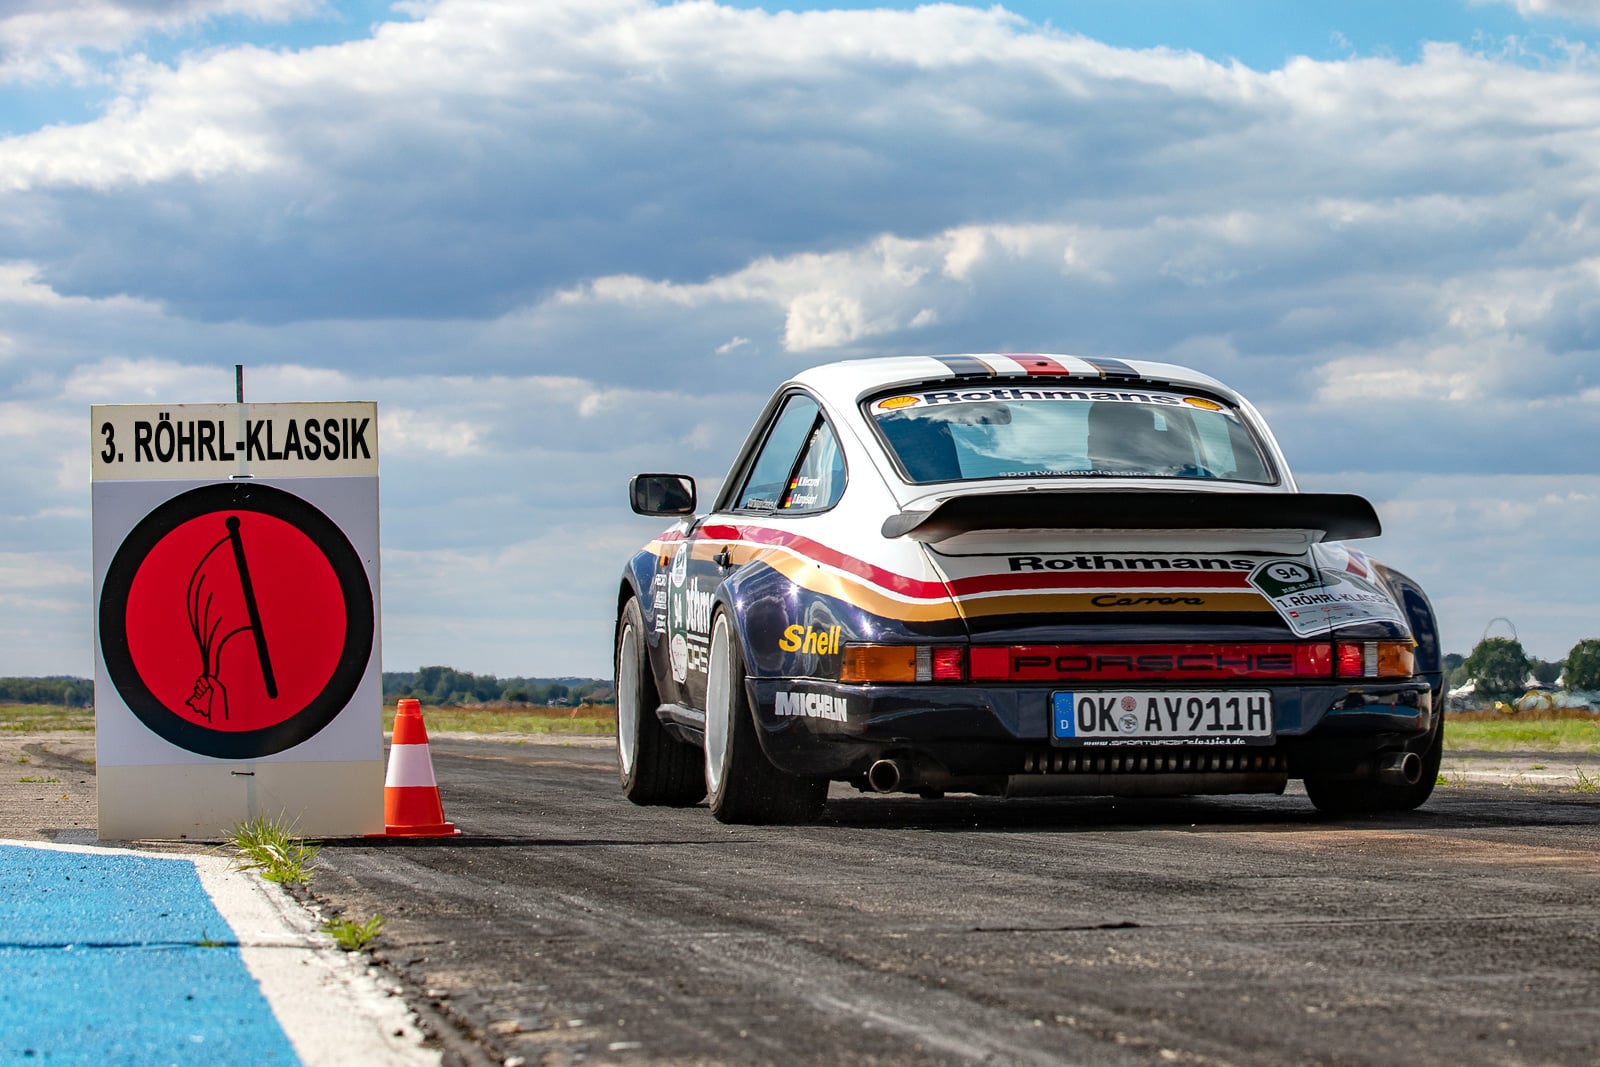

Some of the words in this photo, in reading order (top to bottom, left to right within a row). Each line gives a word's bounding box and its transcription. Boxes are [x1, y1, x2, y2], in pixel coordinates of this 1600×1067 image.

[923, 389, 1180, 405] Rothmans
[100, 422, 124, 464] 3.
[134, 412, 371, 463] RÖHRL-KLASSIK
[1008, 555, 1255, 572] Rothmans
[1275, 567, 1302, 580] 94
[1091, 594, 1206, 608] Carrera
[778, 624, 842, 656] Shell
[1014, 653, 1293, 673] PORSCHE
[774, 691, 848, 723] MICHELIN
[1077, 696, 1119, 733] OK
[1144, 696, 1267, 732] AY911H
[1060, 719, 1070, 730] D
